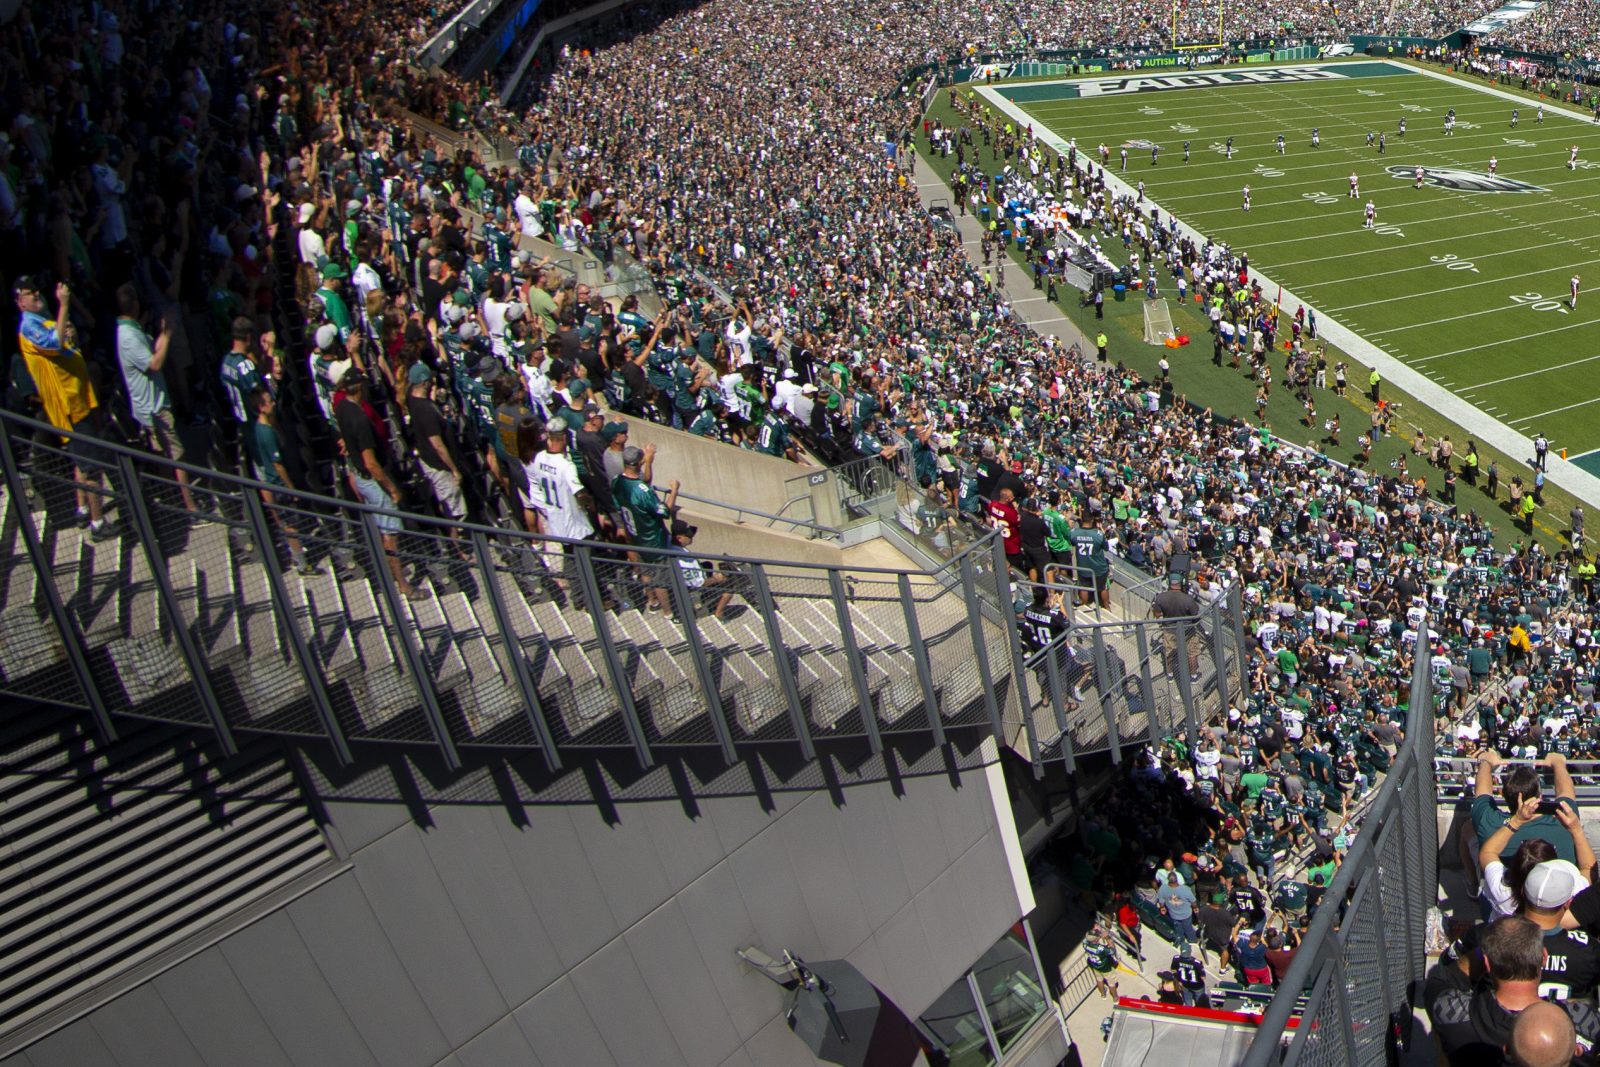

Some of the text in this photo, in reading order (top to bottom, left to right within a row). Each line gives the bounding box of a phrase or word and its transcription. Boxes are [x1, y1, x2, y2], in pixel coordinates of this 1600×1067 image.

[1144, 57, 1175, 68] AUTISM
[1074, 66, 1350, 98] EAGLES
[1302, 191, 1339, 205] 50
[1430, 253, 1475, 272] 30
[1509, 292, 1562, 312] 20
[811, 474, 824, 484] C6
[539, 477, 562, 510] 11
[1238, 531, 1250, 543] 25
[1078, 542, 1094, 556] 27
[1026, 609, 1052, 625] JACKSON
[1236, 898, 1254, 911] 54
[1178, 967, 1197, 983] 11
